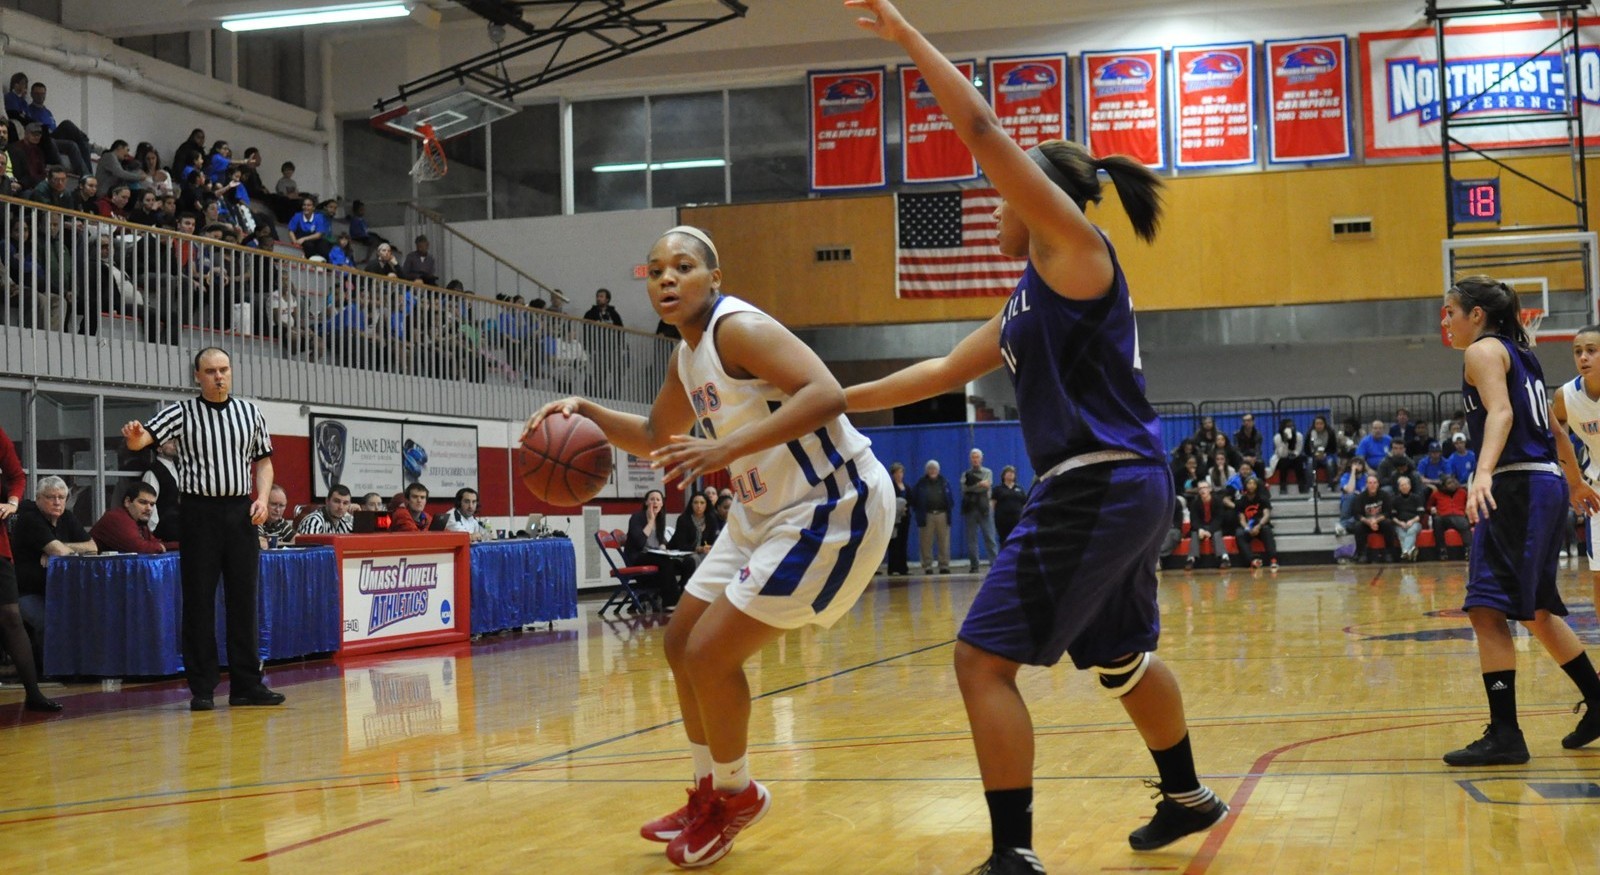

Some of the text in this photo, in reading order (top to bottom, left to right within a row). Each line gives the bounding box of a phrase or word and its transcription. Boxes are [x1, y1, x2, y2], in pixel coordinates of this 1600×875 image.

[1182, 103, 1247, 117] CHAMPIONS
[1276, 96, 1340, 110] CHAMPIONS
[1092, 108, 1155, 121] CHAMPIONS
[818, 127, 878, 140] CHAMPIONS
[1469, 186, 1495, 216] 18
[351, 436, 379, 455] JEANNE
[397, 558, 438, 590] LOWELL
[370, 590, 429, 630] ATHLETICS
